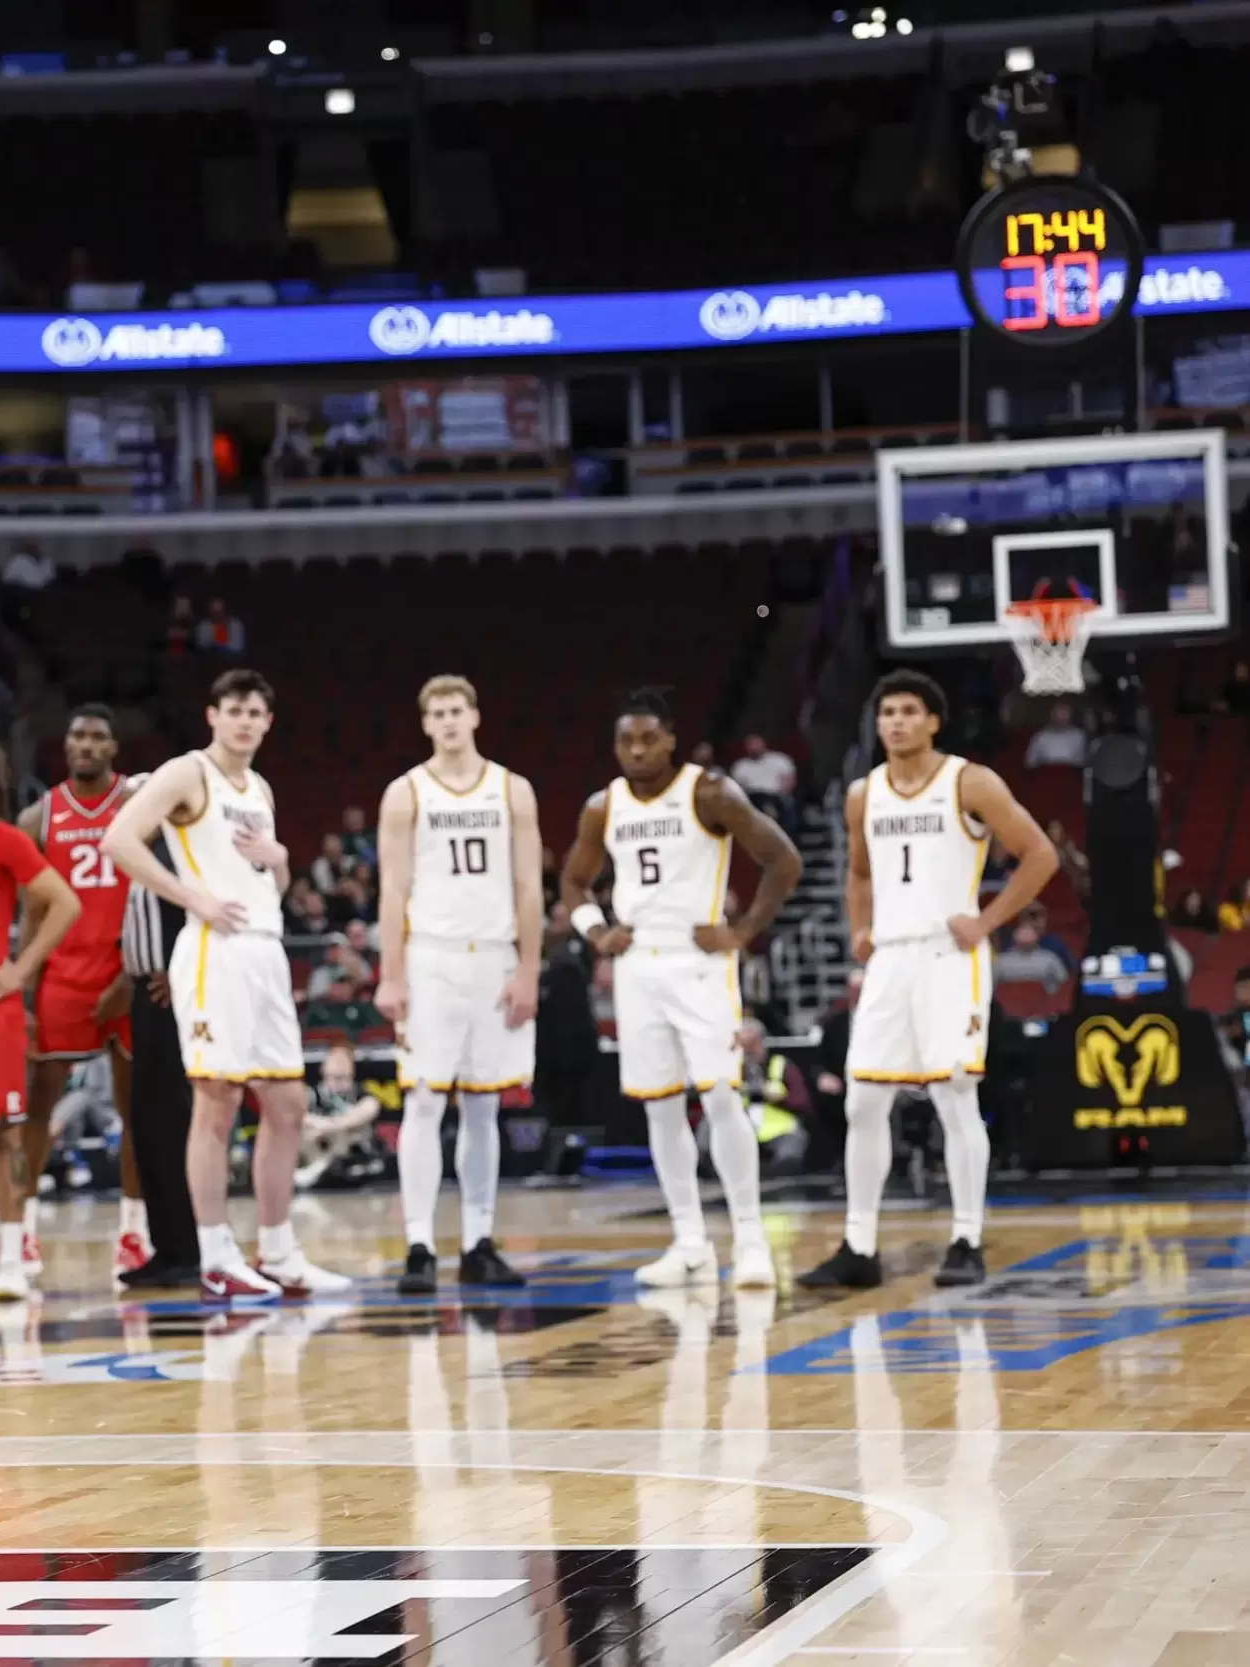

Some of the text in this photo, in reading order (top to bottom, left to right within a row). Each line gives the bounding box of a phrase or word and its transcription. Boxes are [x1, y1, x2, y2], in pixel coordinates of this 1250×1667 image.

[1006, 207, 1107, 257] 17:44
[758, 289, 885, 332] Allstate
[1000, 250, 1103, 332] 30
[100, 322, 225, 361] Allstate
[429, 309, 554, 348] Allstate
[70, 844, 118, 889] 21
[448, 836, 489, 876] 10
[636, 846, 662, 886] 6
[901, 843, 913, 884] 1
